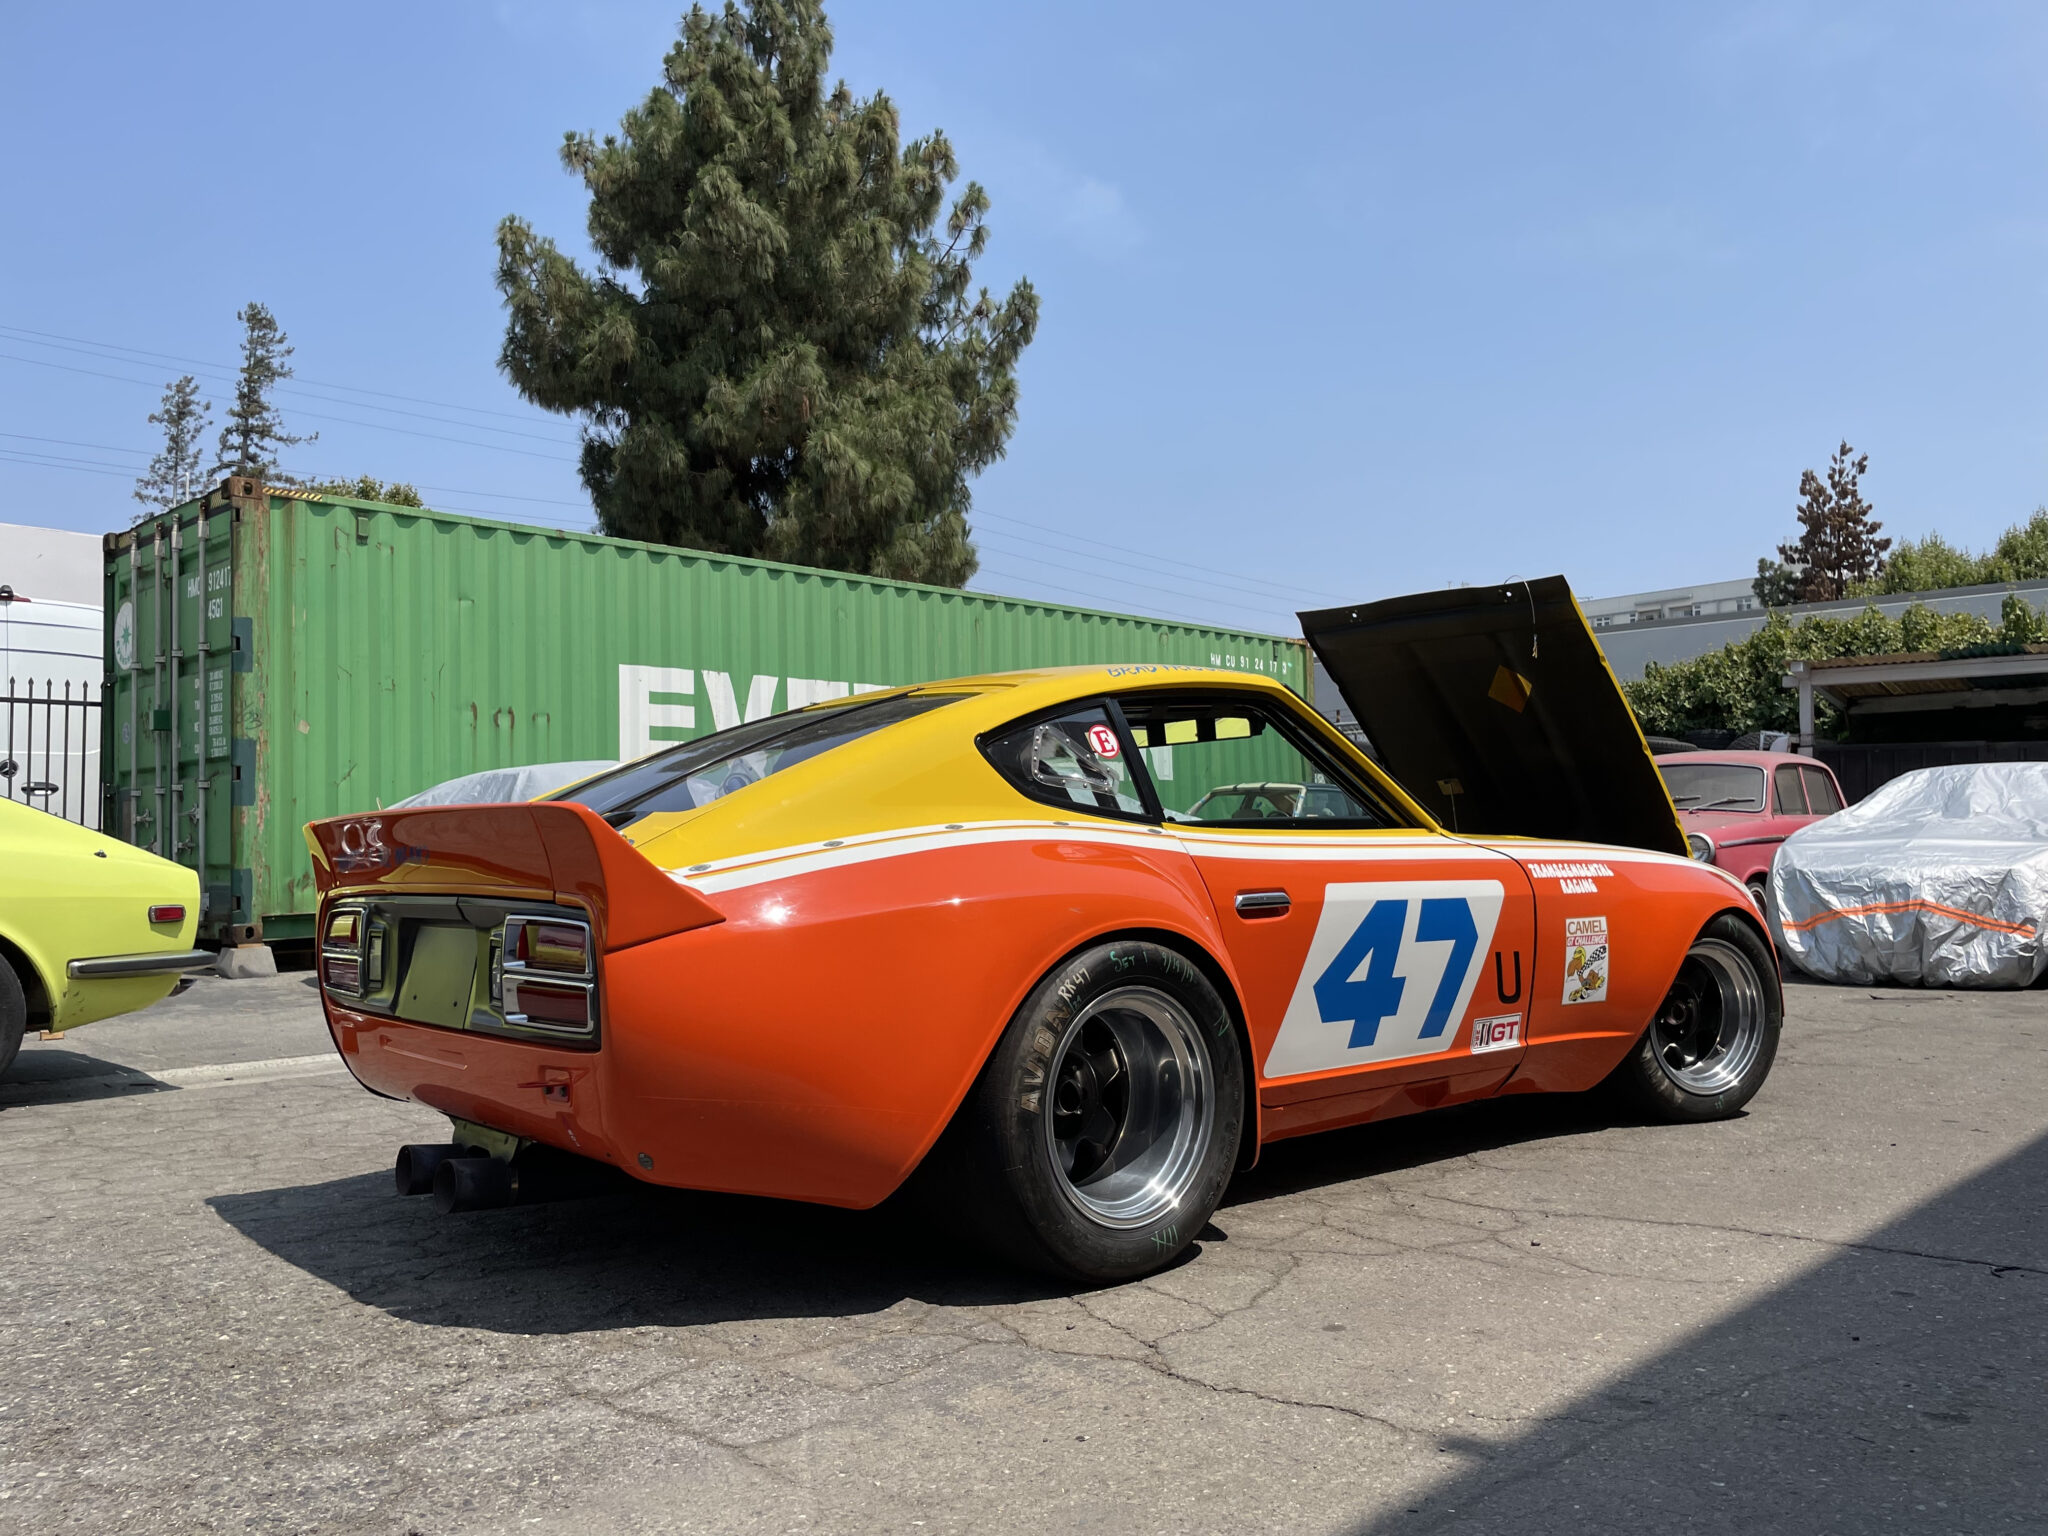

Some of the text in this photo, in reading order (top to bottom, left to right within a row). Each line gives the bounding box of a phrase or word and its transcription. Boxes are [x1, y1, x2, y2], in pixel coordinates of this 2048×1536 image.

[208, 597, 223, 620] 45G1
[1210, 652, 1221, 667] HM
[1225, 654, 1236, 668] CU
[1240, 655, 1249, 669] 91
[1254, 657, 1264, 671] 24
[1269, 660, 1277, 673] 17
[1092, 729, 1116, 754] E
[1527, 863, 1614, 878] TRANSCENDENTAL
[1559, 878, 1598, 894] RACING
[1567, 919, 1606, 935] CAMEL
[1313, 897, 1479, 1049] 47
[1494, 951, 1521, 1004] U
[1491, 1021, 1519, 1042] GT
[1020, 1004, 1072, 1114] AVON
